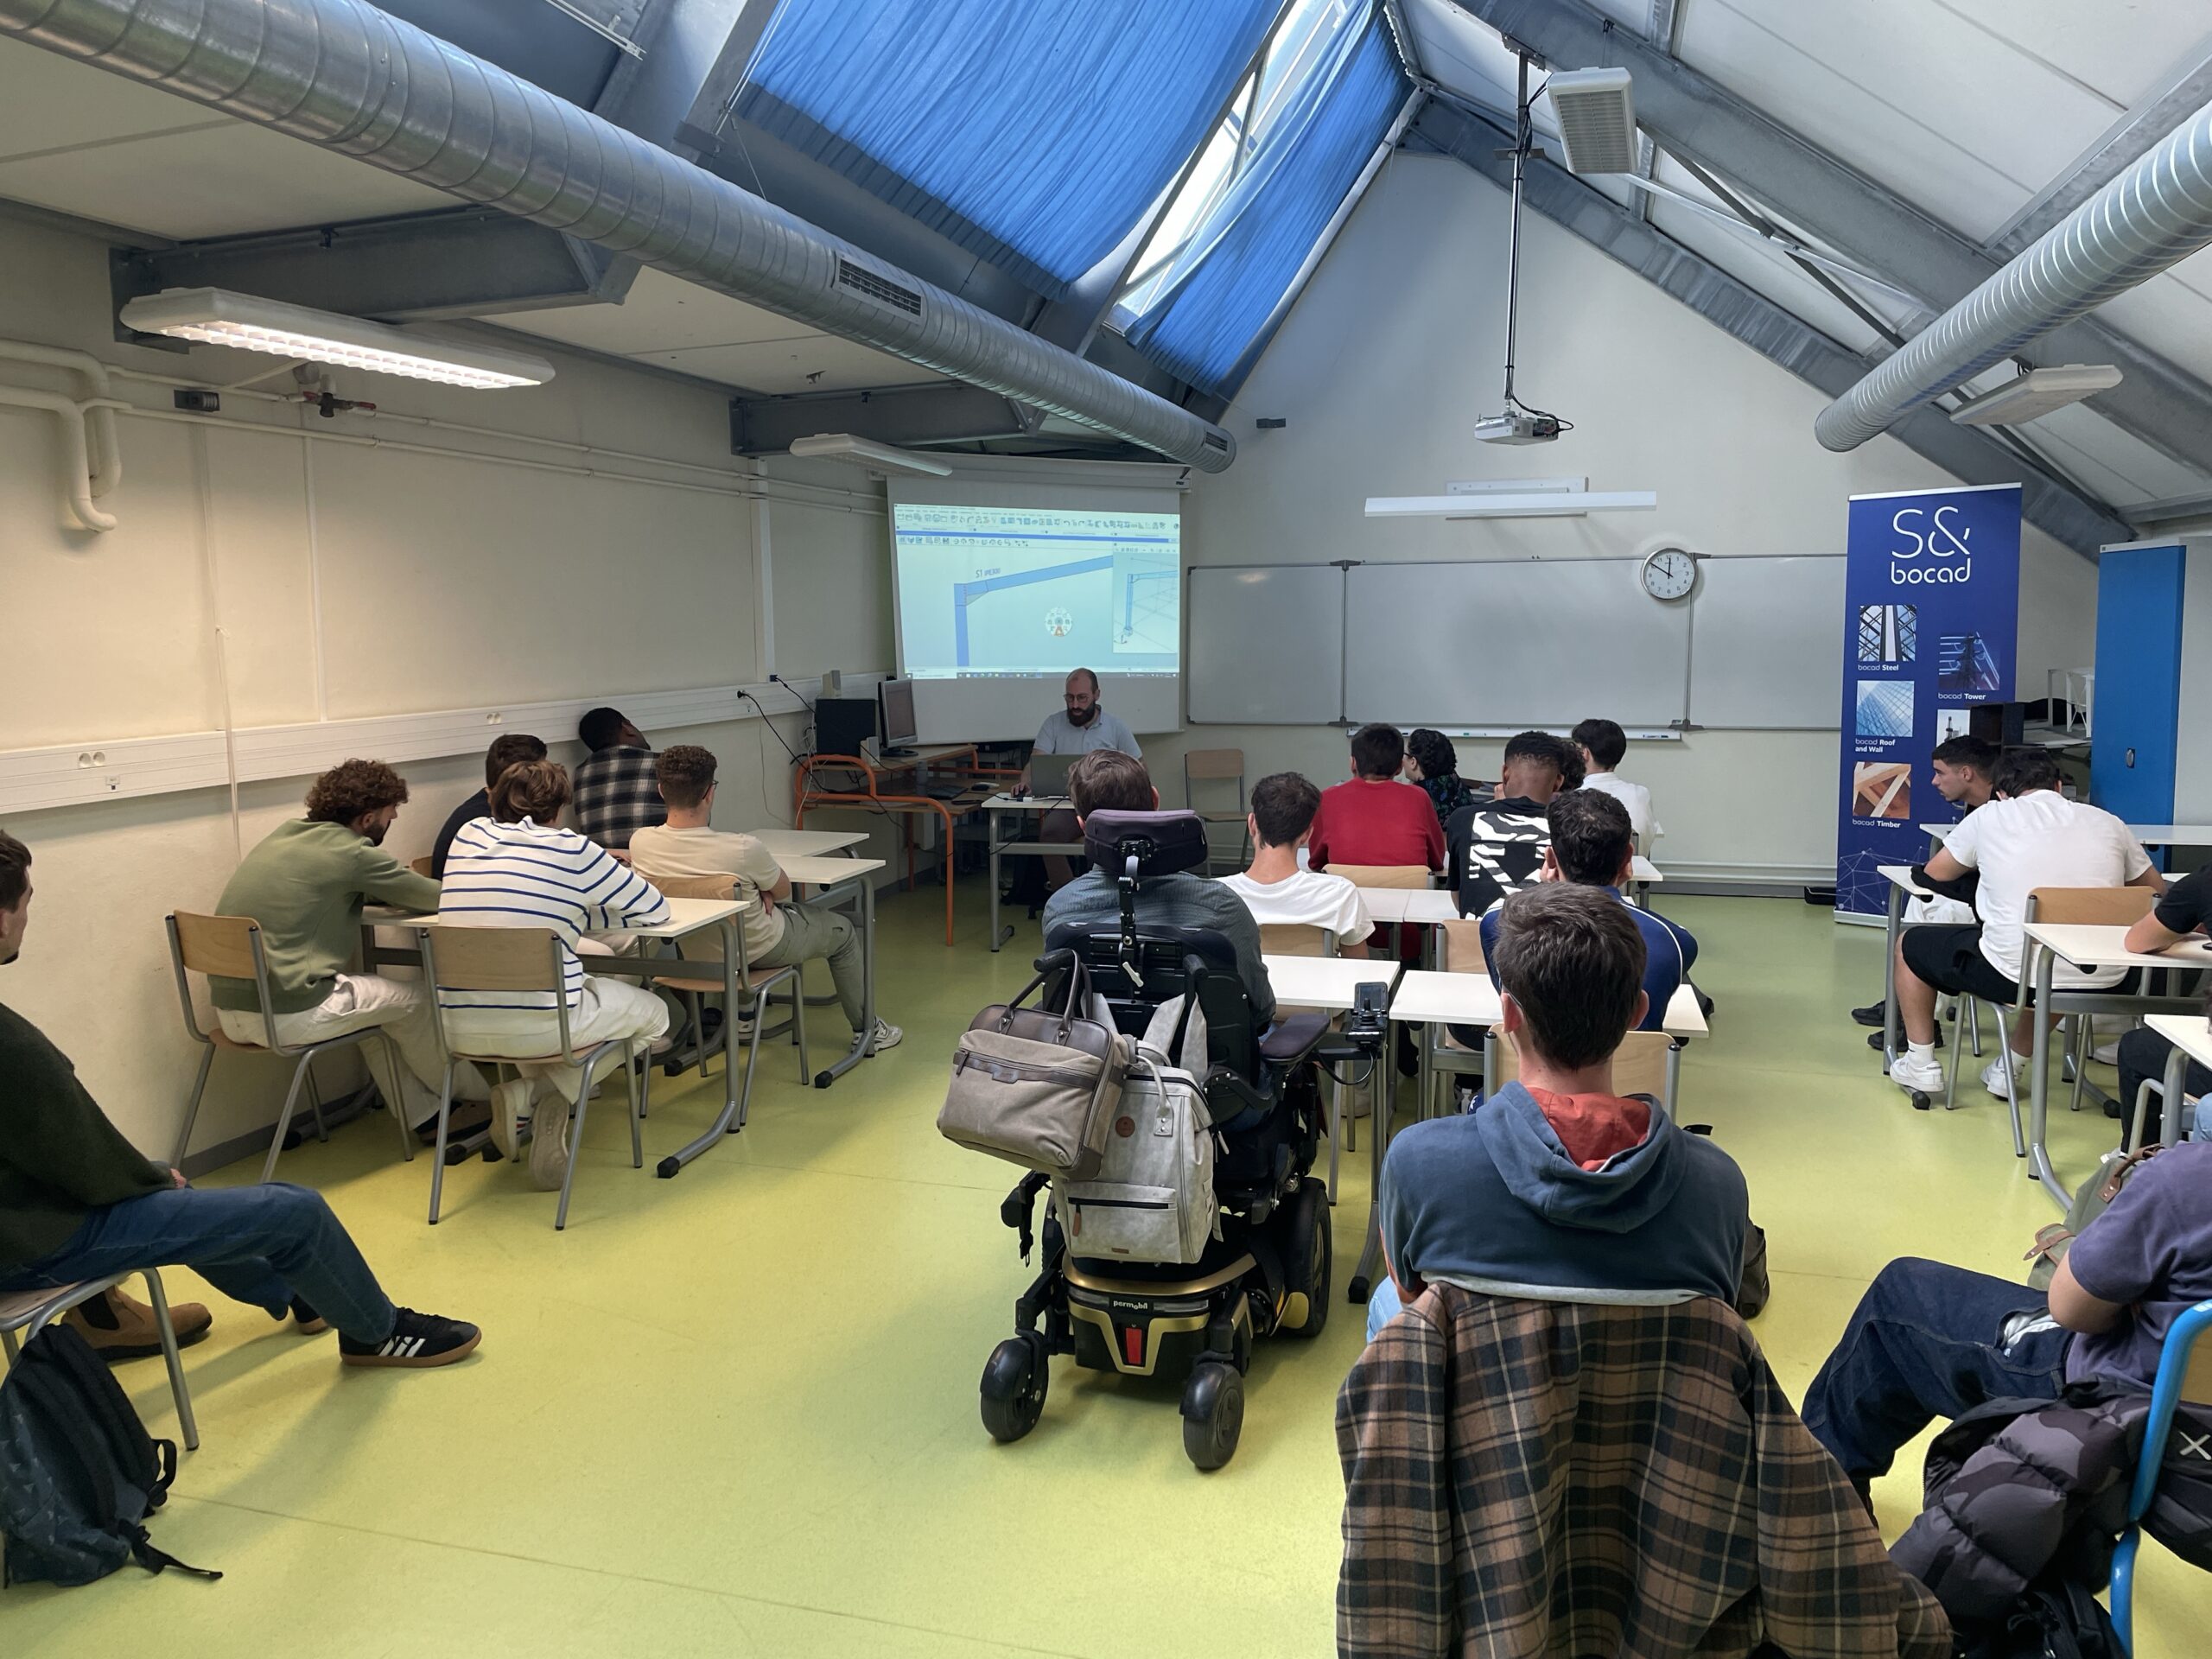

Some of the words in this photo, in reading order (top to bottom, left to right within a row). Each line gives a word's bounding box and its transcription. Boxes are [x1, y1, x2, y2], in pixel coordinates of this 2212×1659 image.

[1891, 505, 1971, 559] S&
[1891, 557, 1971, 585] bocad
[1964, 692, 1986, 701] Tower
[1879, 738, 1896, 747] Roof
[1853, 818, 1875, 827] bocad
[1876, 820, 1901, 829] Timber
[1113, 1300, 1148, 1310] permobil
